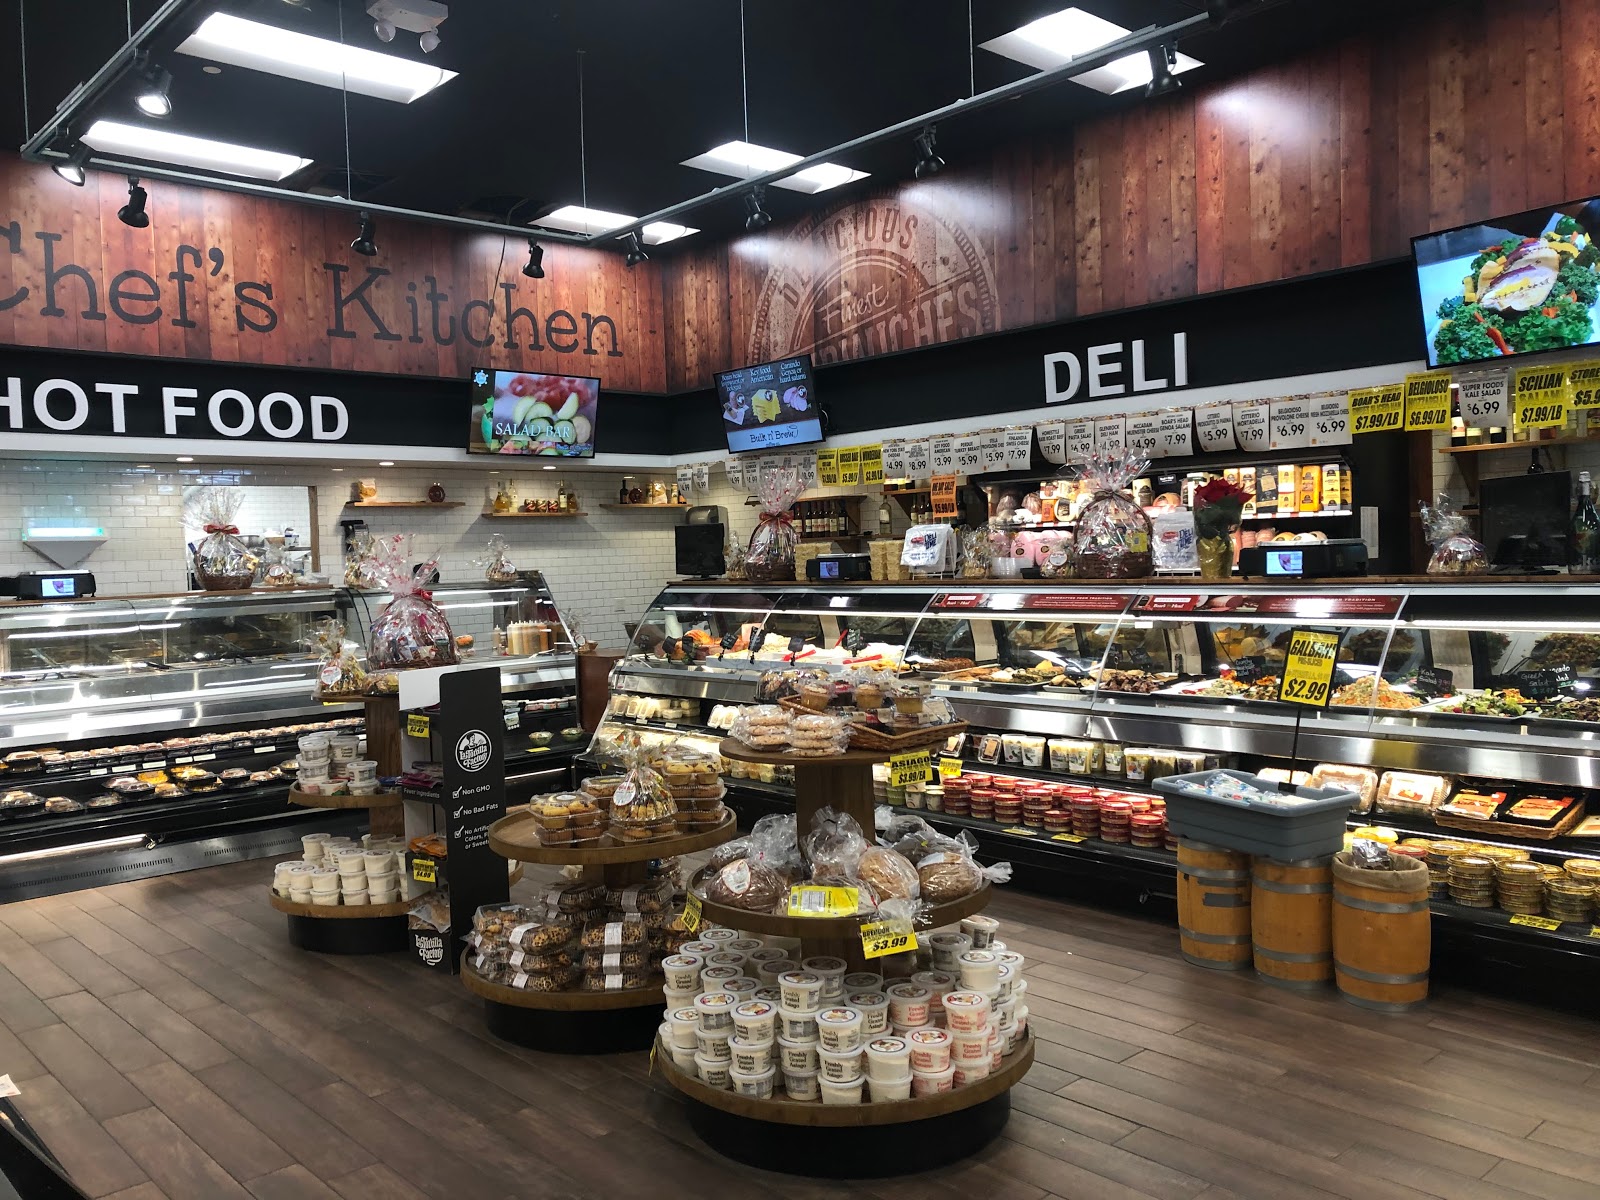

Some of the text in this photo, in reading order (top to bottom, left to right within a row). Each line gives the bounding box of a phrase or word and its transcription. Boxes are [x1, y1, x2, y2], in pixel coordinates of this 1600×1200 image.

[781, 207, 919, 310] DEICIOUS
[323, 262, 623, 357] Kitchen
[815, 283, 889, 335] Finest
[1044, 332, 1188, 403] DELI
[1462, 381, 1504, 392] SUPER FOODS
[1518, 372, 1564, 392] SCILIAN
[1352, 394, 1380, 407] BOAR'S
[1381, 392, 1402, 403] HEAD
[1465, 388, 1501, 399] KALE SALAD
[0, 377, 349, 440] HOT FOOD
[1467, 401, 1499, 415] $6.99
[1521, 404, 1563, 424] $7.99/LB
[1237, 418, 1265, 427] MORTADELLA
[1241, 412, 1260, 420] CITTERIO
[1271, 414, 1295, 422] PROVOLONE
[1355, 412, 1399, 431] $7.99/LB
[1410, 409, 1446, 427] $6.99/LB
[495, 422, 570, 438] SALAD BAR
[1276, 424, 1305, 437] $6.99
[1316, 420, 1346, 434] $6.99
[750, 433, 766, 443] Bulk
[776, 430, 795, 441] Brew
[1165, 434, 1187, 445] $7.99
[1203, 428, 1227, 441] $5.99
[1240, 428, 1263, 441] $7.99
[1044, 444, 1061, 454] $7.99
[1132, 438, 1156, 449] $4.99
[934, 456, 952, 466] $3.99
[958, 455, 977, 465] $5.99
[986, 452, 1004, 462] $5.99
[1008, 450, 1026, 460] $7.99
[886, 461, 903, 470] $4.99
[909, 461, 926, 470] $8.99
[1284, 678, 1327, 701] $2.99
[463, 753, 488, 768] Factory
[892, 756, 930, 768] ASIAGO
[898, 770, 926, 784] $3.99/EA
[462, 785, 491, 796] Non GMO
[473, 805, 485, 814] Bad
[486, 803, 499, 811] Fats
[474, 825, 490, 834] Artific
[464, 834, 484, 843] Colors,
[472, 839, 489, 848] Sweet
[873, 936, 908, 952] $3.99
